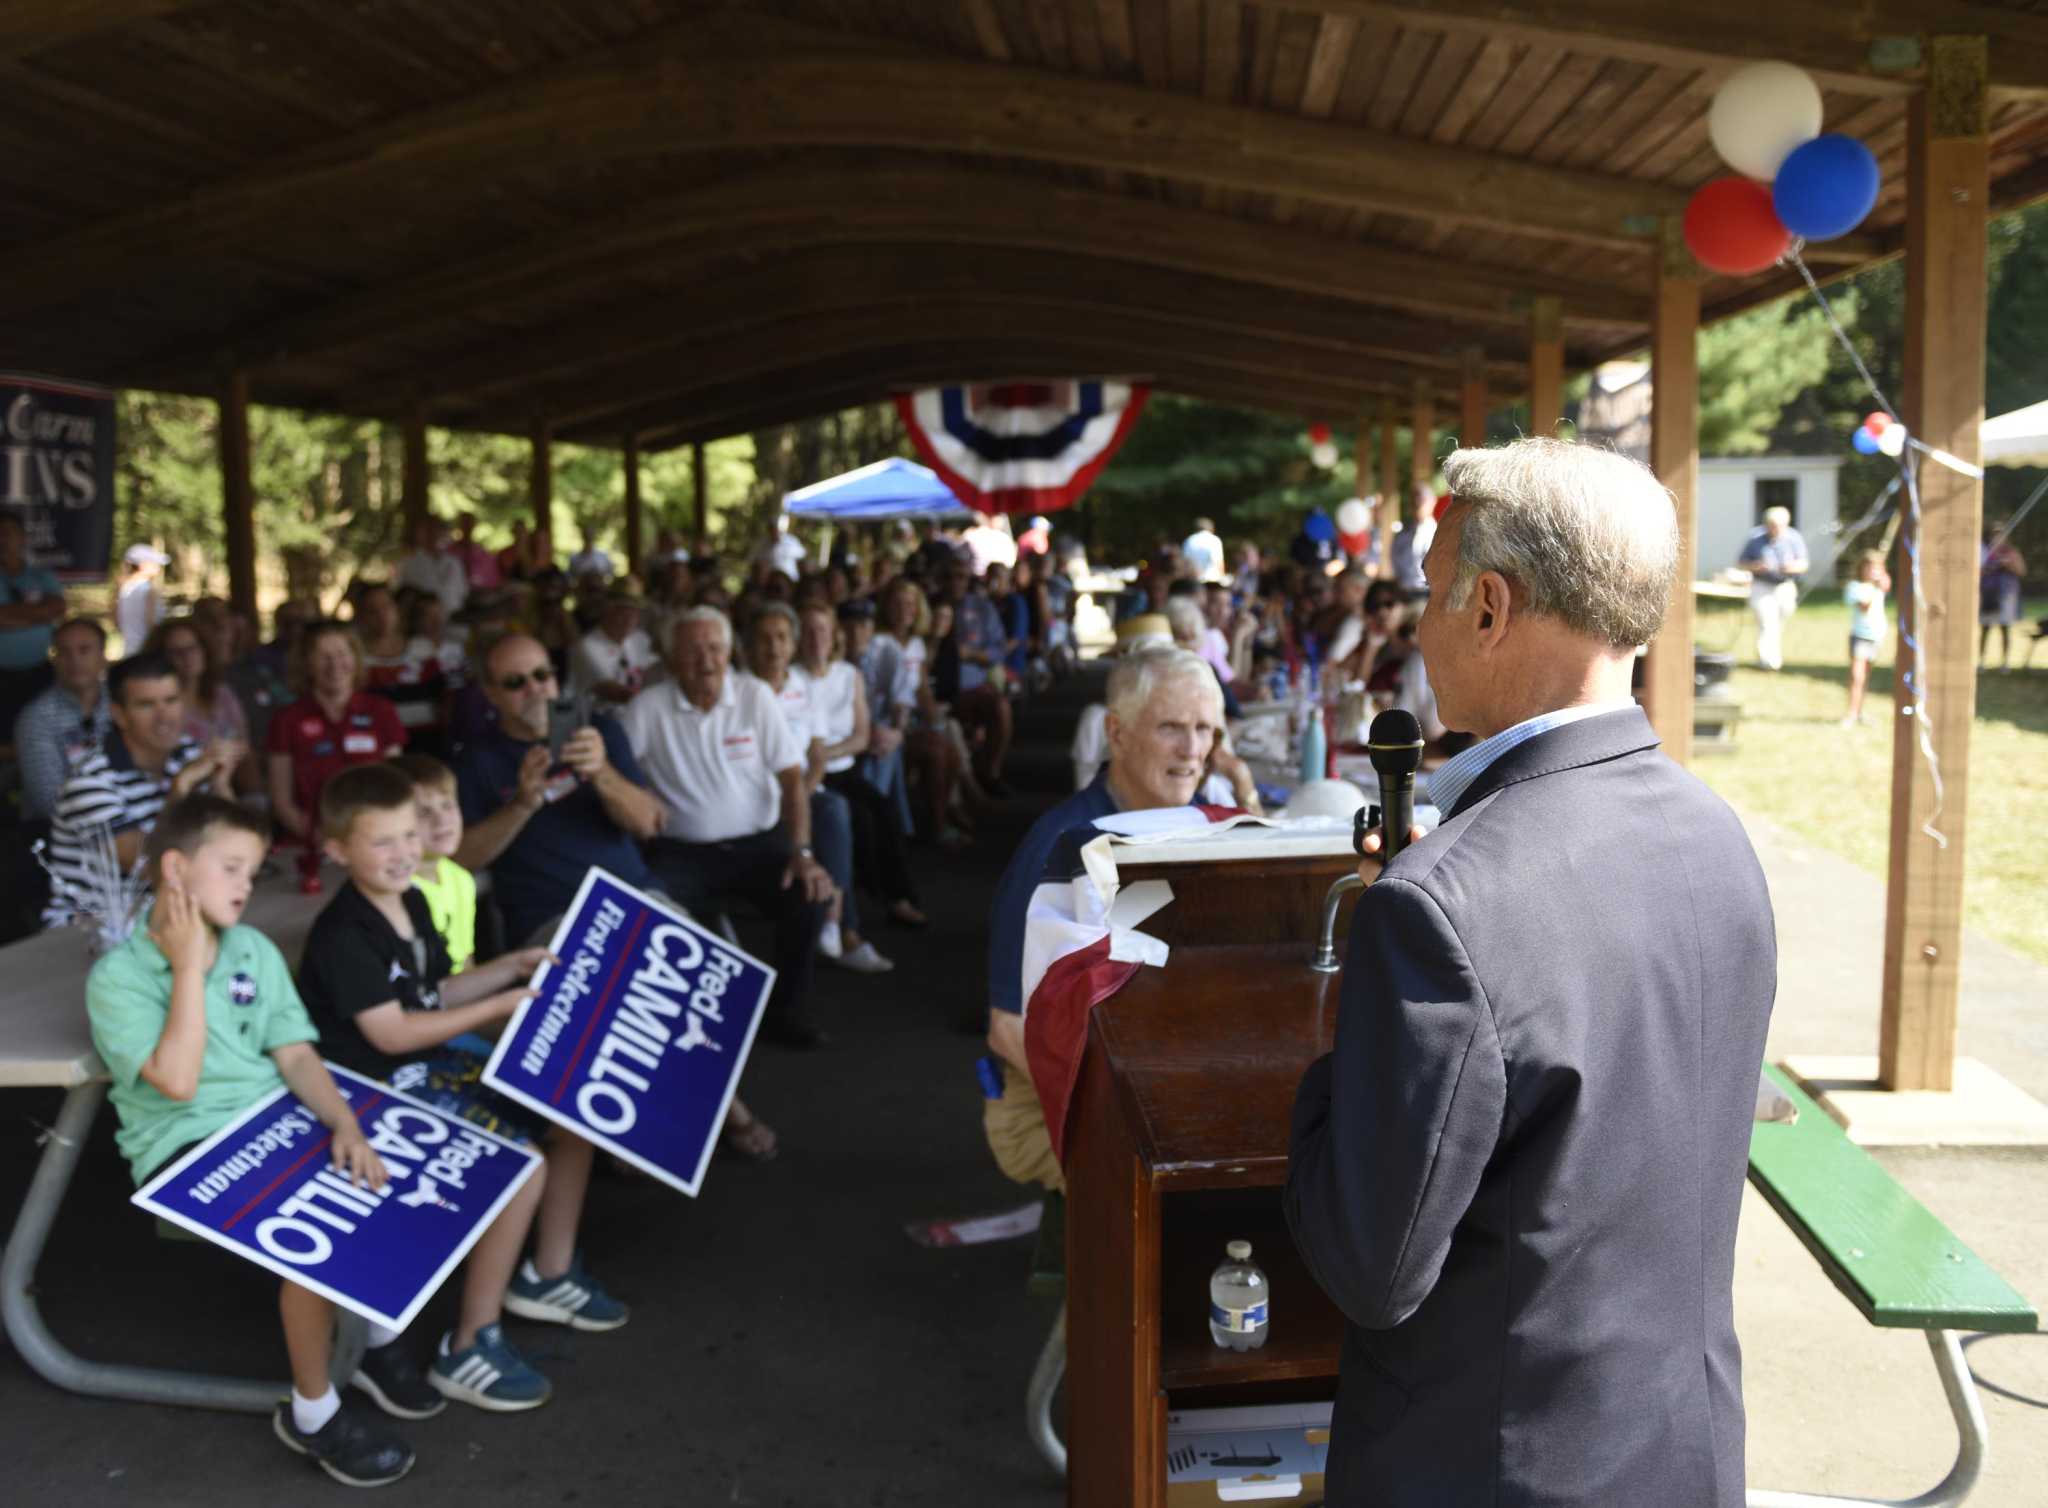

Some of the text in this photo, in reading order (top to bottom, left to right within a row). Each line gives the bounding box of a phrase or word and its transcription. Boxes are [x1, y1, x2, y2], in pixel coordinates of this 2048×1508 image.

[520, 898, 626, 1077] First Selectman
[576, 923, 703, 1135] CAMILLO
[689, 946, 744, 1023] Fred
[188, 1112, 312, 1205] Selectman
[423, 1129, 501, 1190] Fred
